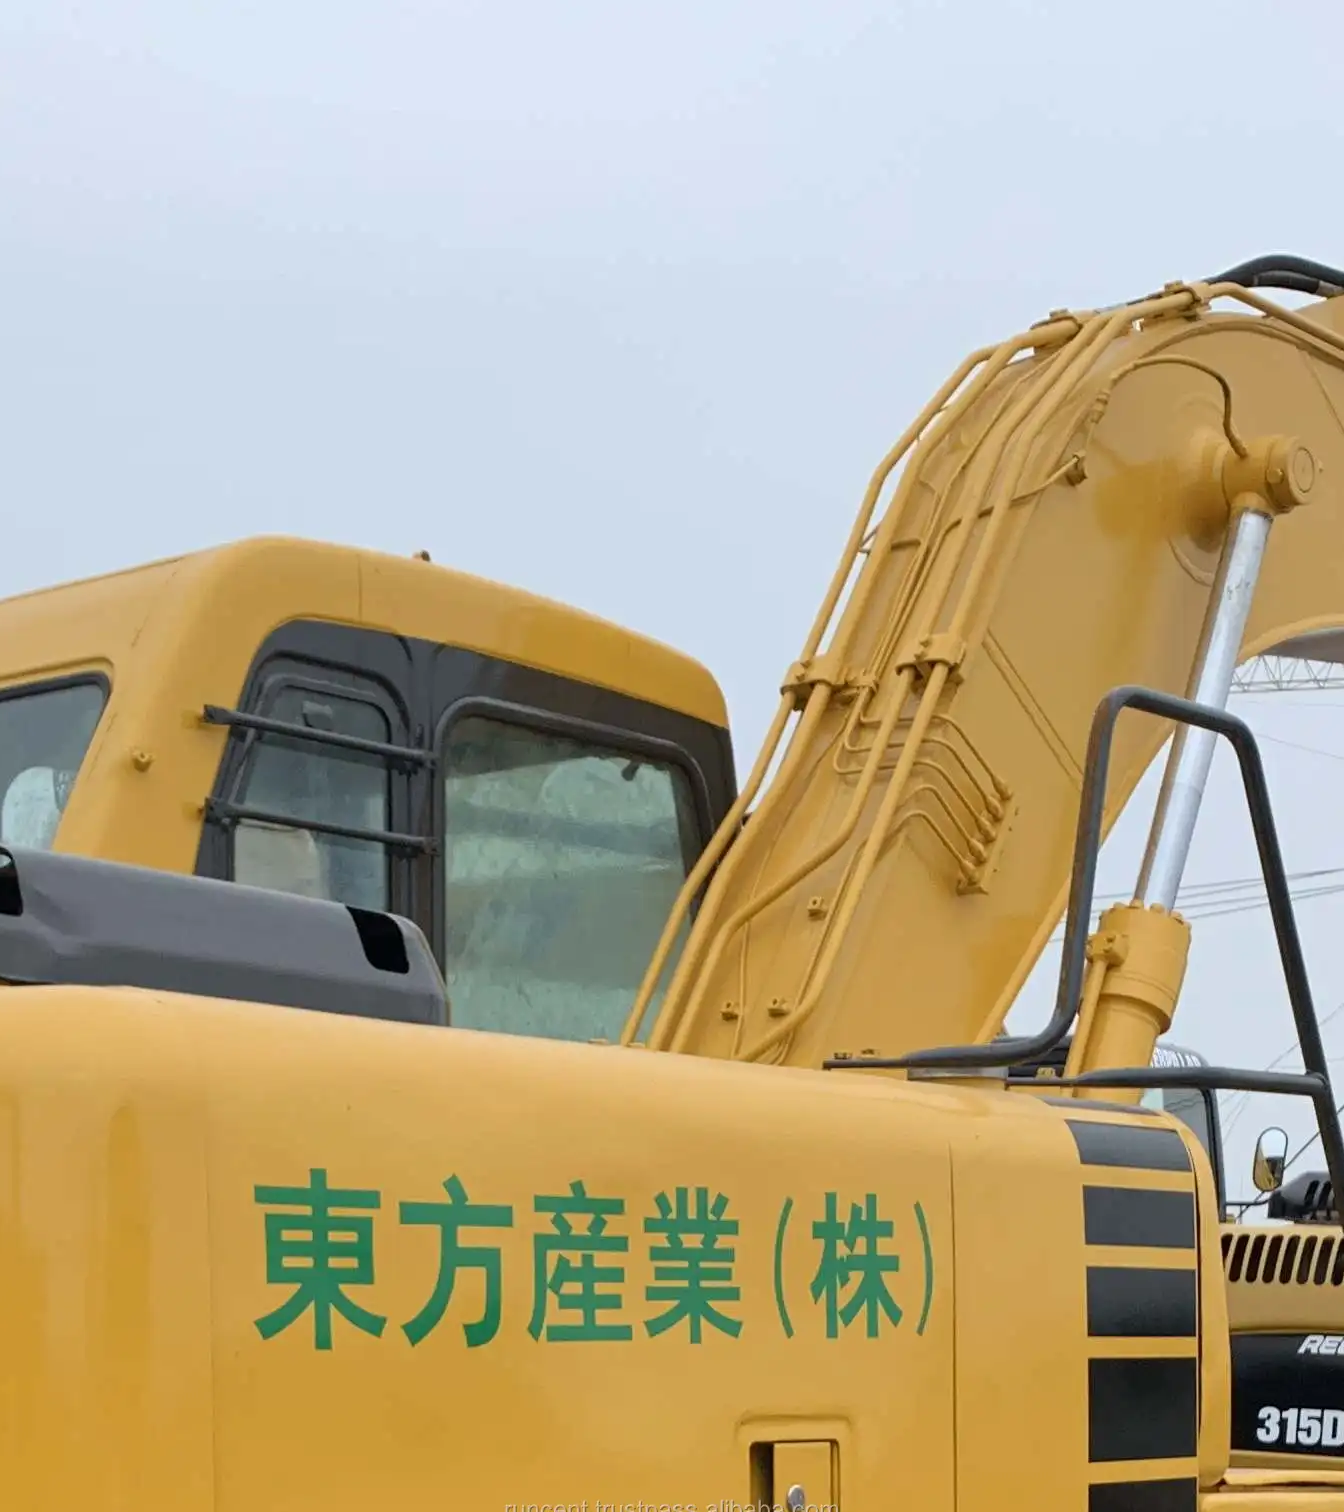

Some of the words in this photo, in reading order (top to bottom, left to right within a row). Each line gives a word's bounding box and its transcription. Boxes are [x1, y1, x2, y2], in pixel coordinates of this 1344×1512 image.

[253, 1167, 934, 1350] 東方産業(株)
